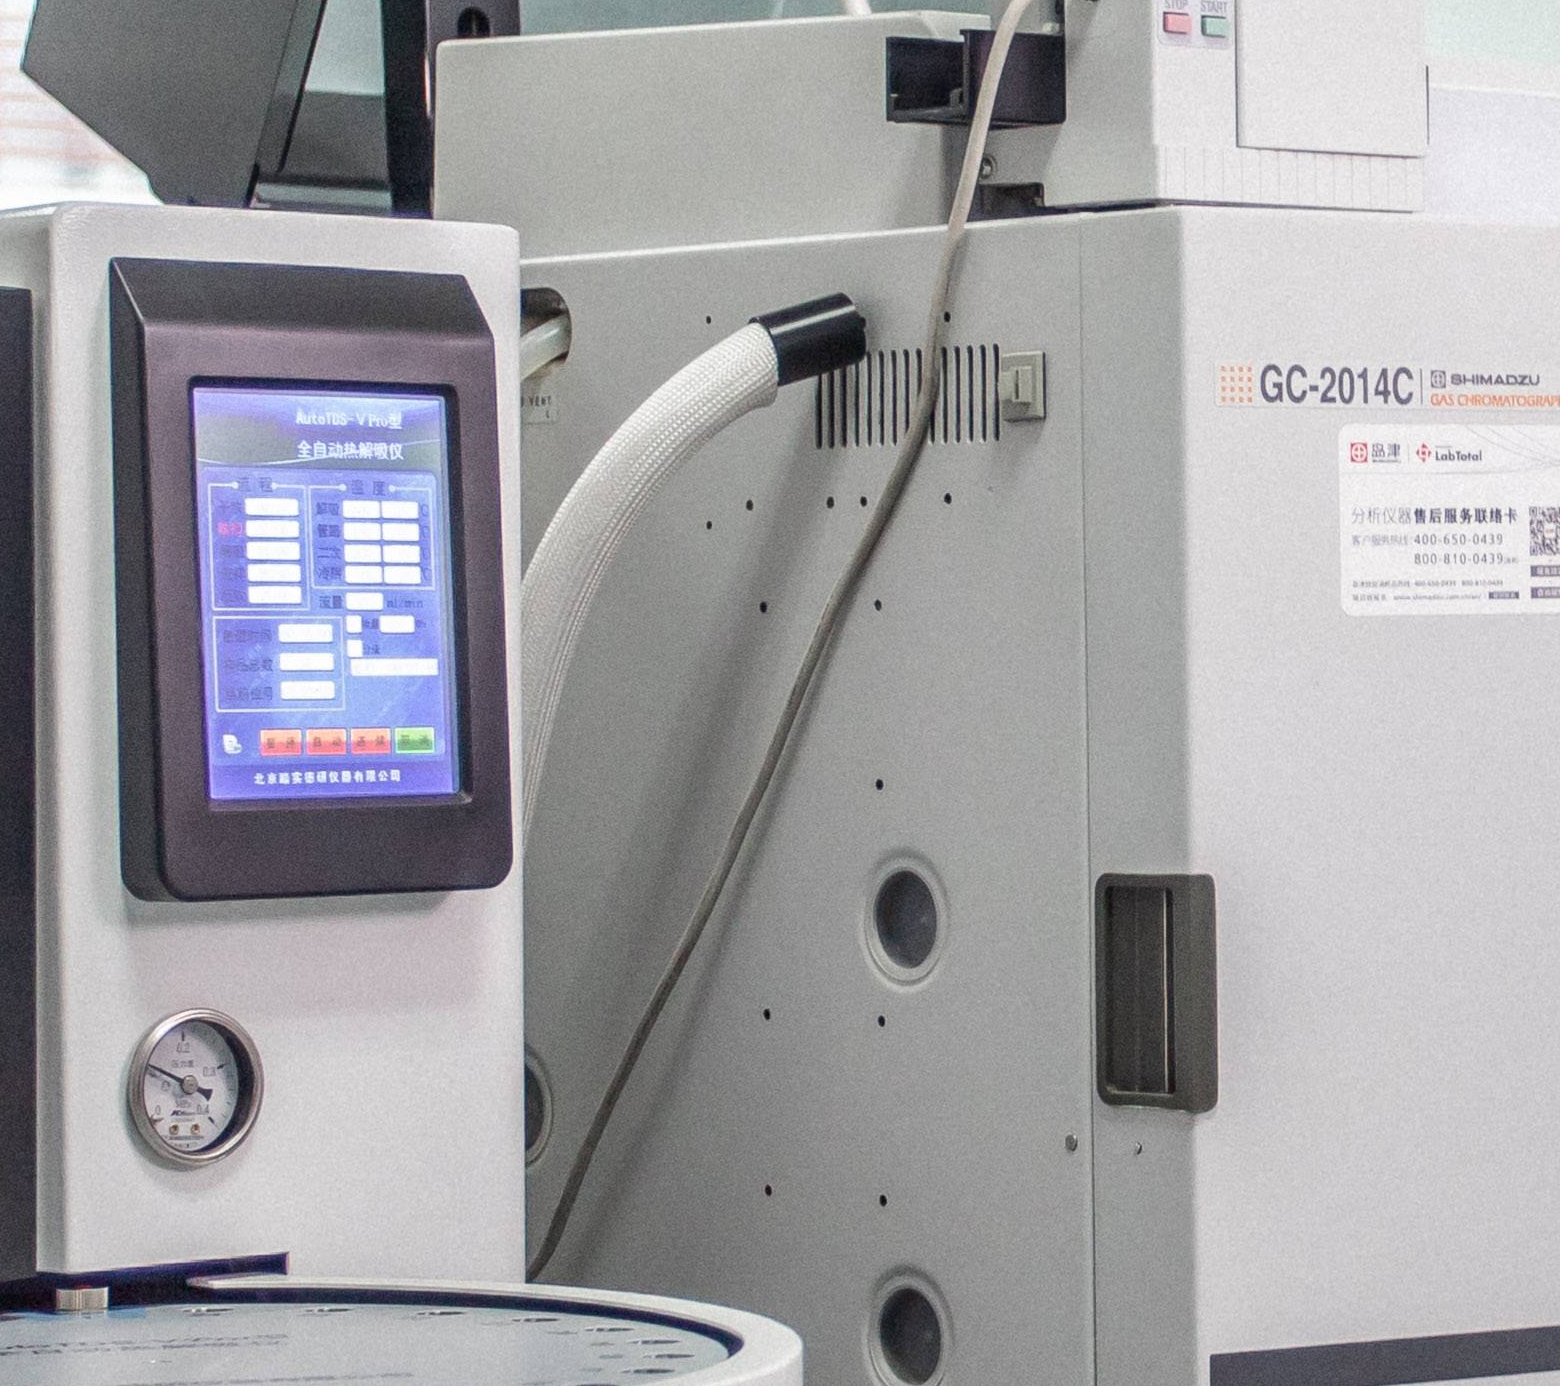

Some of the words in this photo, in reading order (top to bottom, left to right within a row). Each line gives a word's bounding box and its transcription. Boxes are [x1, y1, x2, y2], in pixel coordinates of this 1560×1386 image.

[1201, 0, 1227, 13] START
[1260, 364, 1414, 405] GC-2014C
[1451, 373, 1541, 386] SHIMADZU
[1430, 393, 1456, 407] GAS
[297, 440, 404, 460] 全自动热解吸仪
[1435, 449, 1483, 462] LabTotal
[1352, 507, 1518, 525] 分析仪器售后服务联络卡
[1414, 533, 1503, 546] 400-650-0439
[1414, 553, 1504, 565] 800-810-0439
